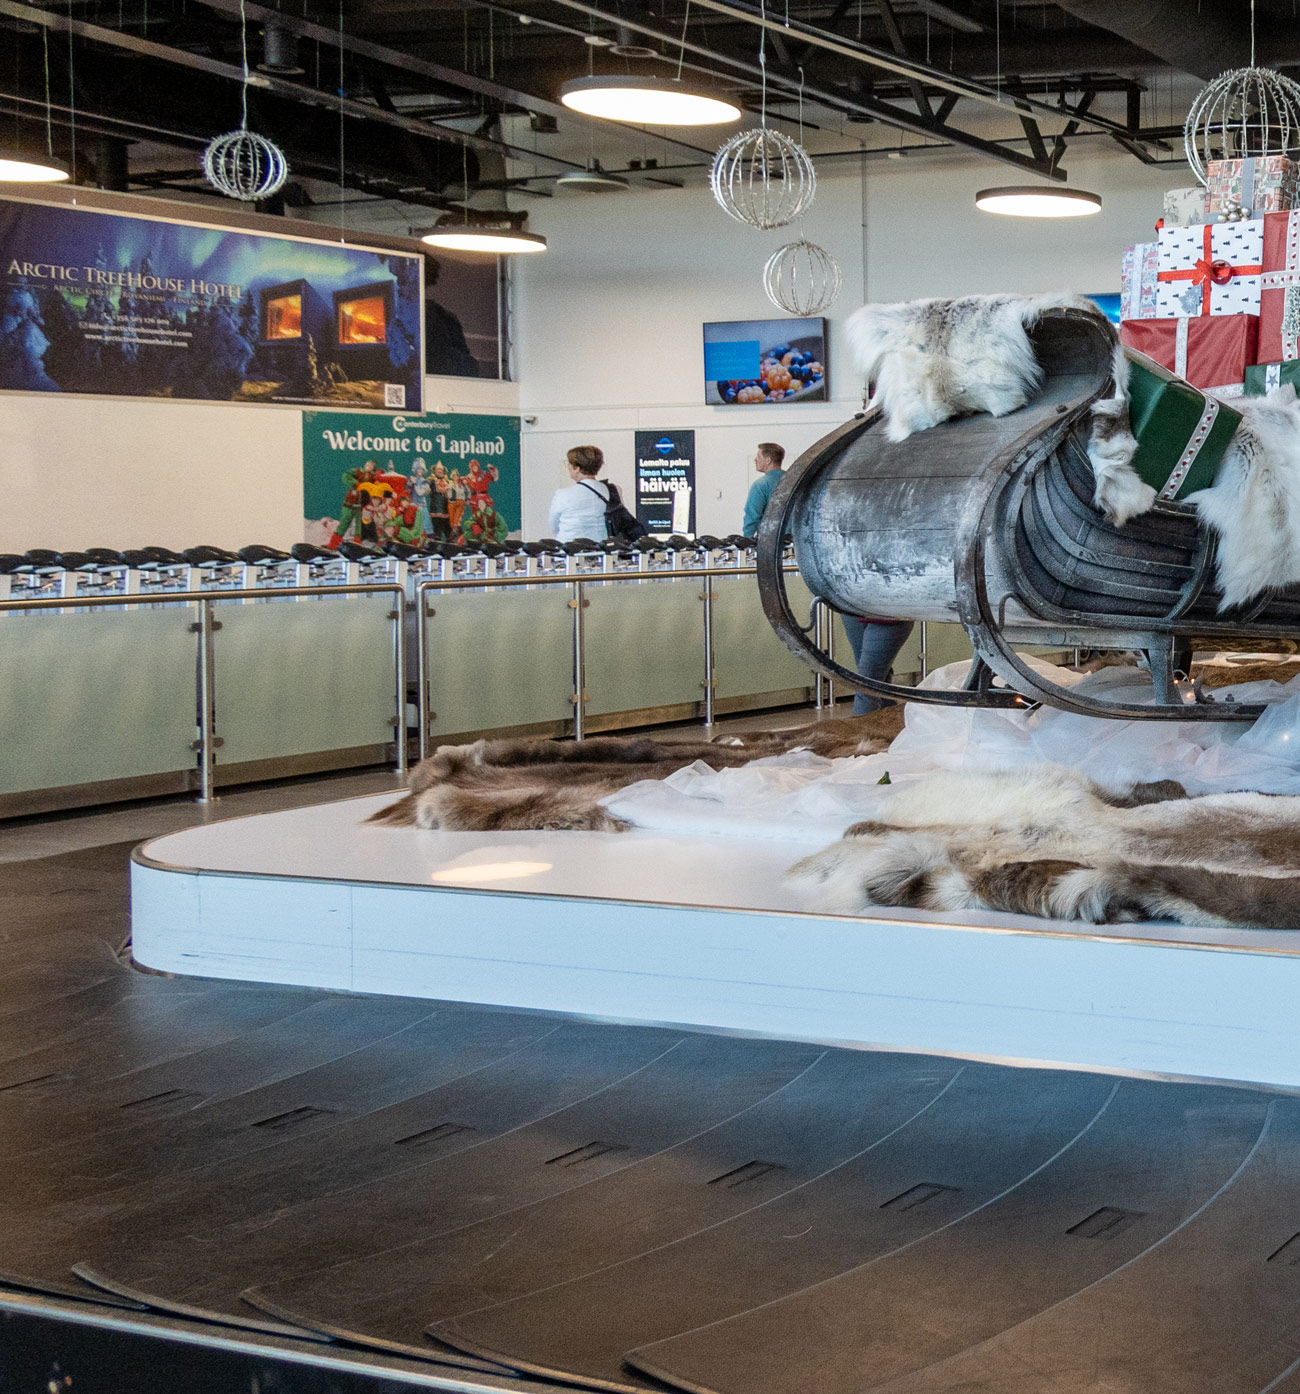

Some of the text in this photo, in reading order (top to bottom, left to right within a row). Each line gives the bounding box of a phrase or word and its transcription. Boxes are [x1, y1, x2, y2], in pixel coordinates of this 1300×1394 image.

[7, 259, 79, 281] ARCTIC
[191, 279, 244, 300] HOTEL
[322, 430, 505, 459] Welcome to Lapland
[640, 477, 692, 493] häivää.
